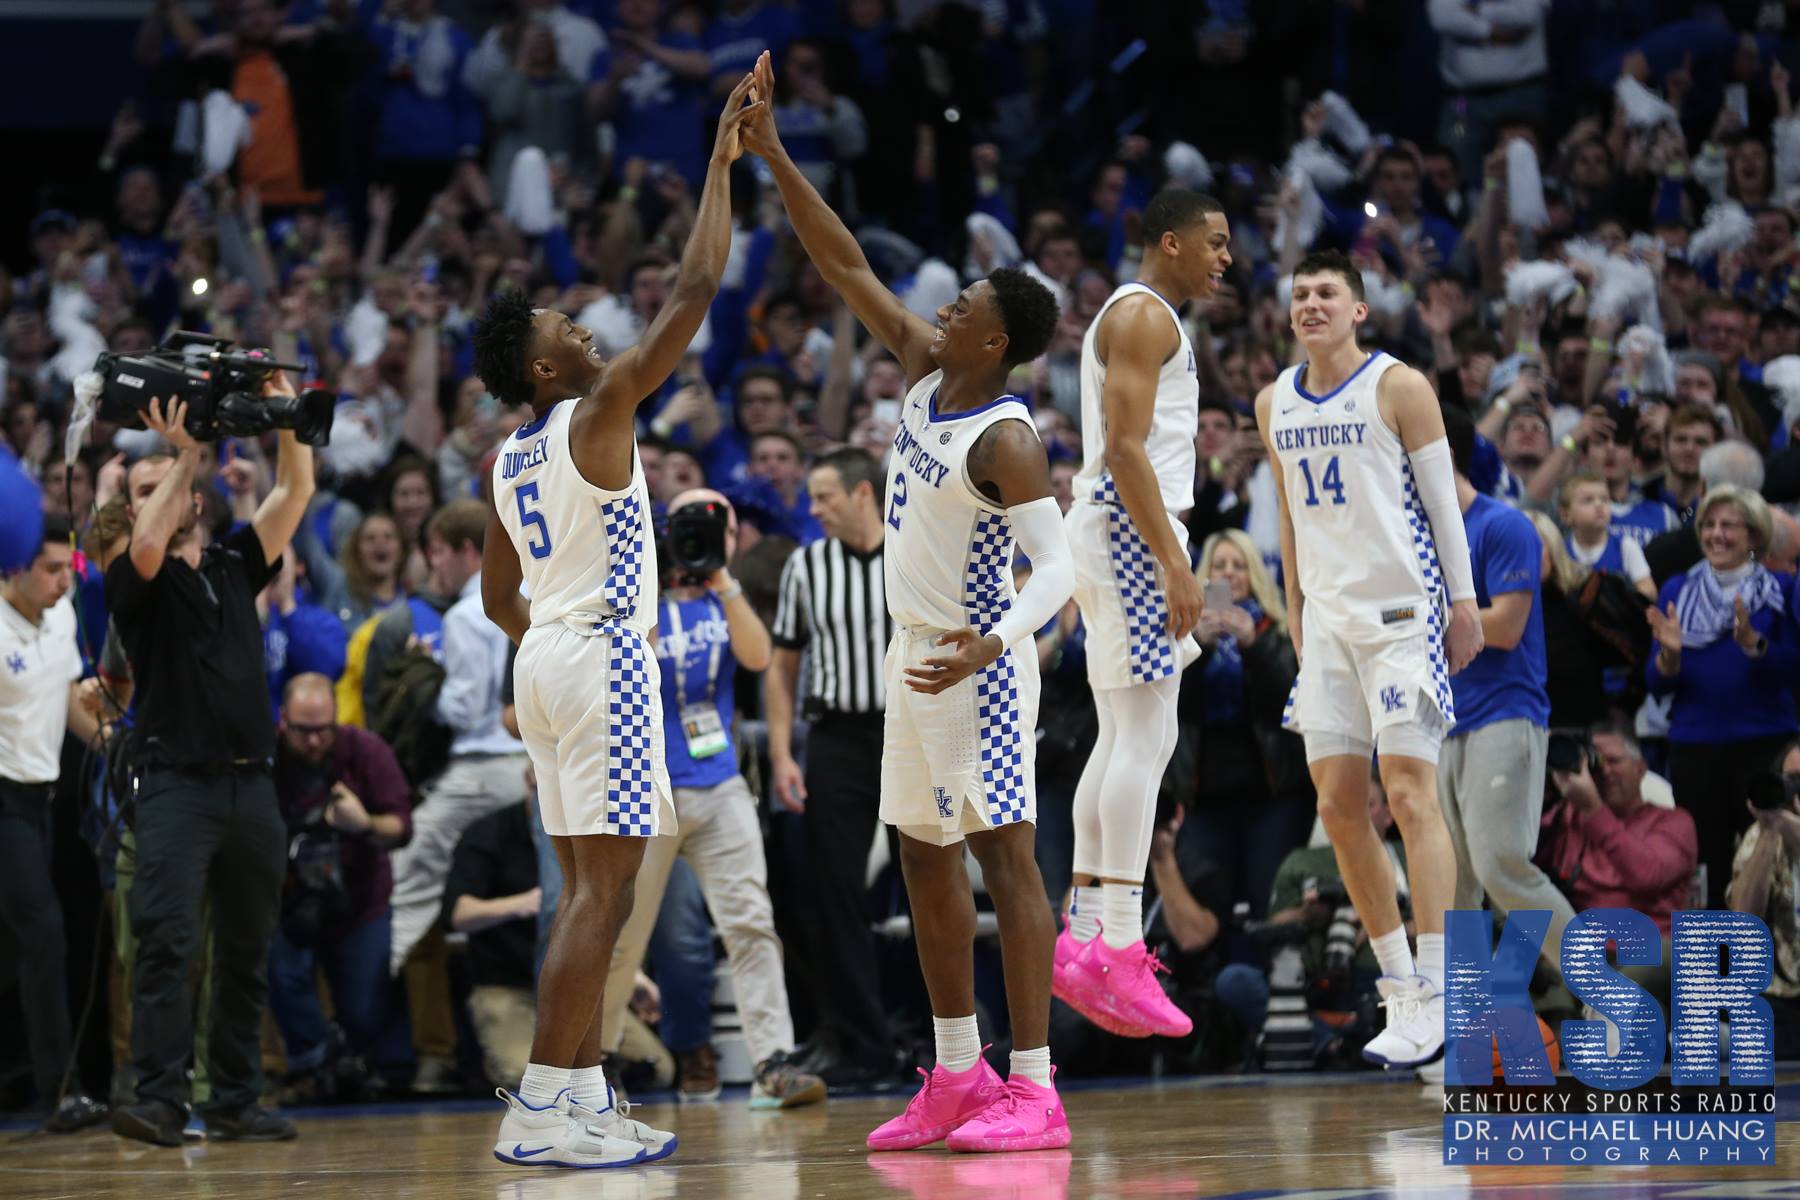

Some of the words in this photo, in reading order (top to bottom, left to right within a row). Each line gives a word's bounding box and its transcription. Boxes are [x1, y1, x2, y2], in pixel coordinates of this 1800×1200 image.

[1275, 423, 1367, 451] KENTUCKY
[887, 472, 908, 531] 2
[1298, 455, 1346, 506] 14
[515, 481, 552, 559] 5
